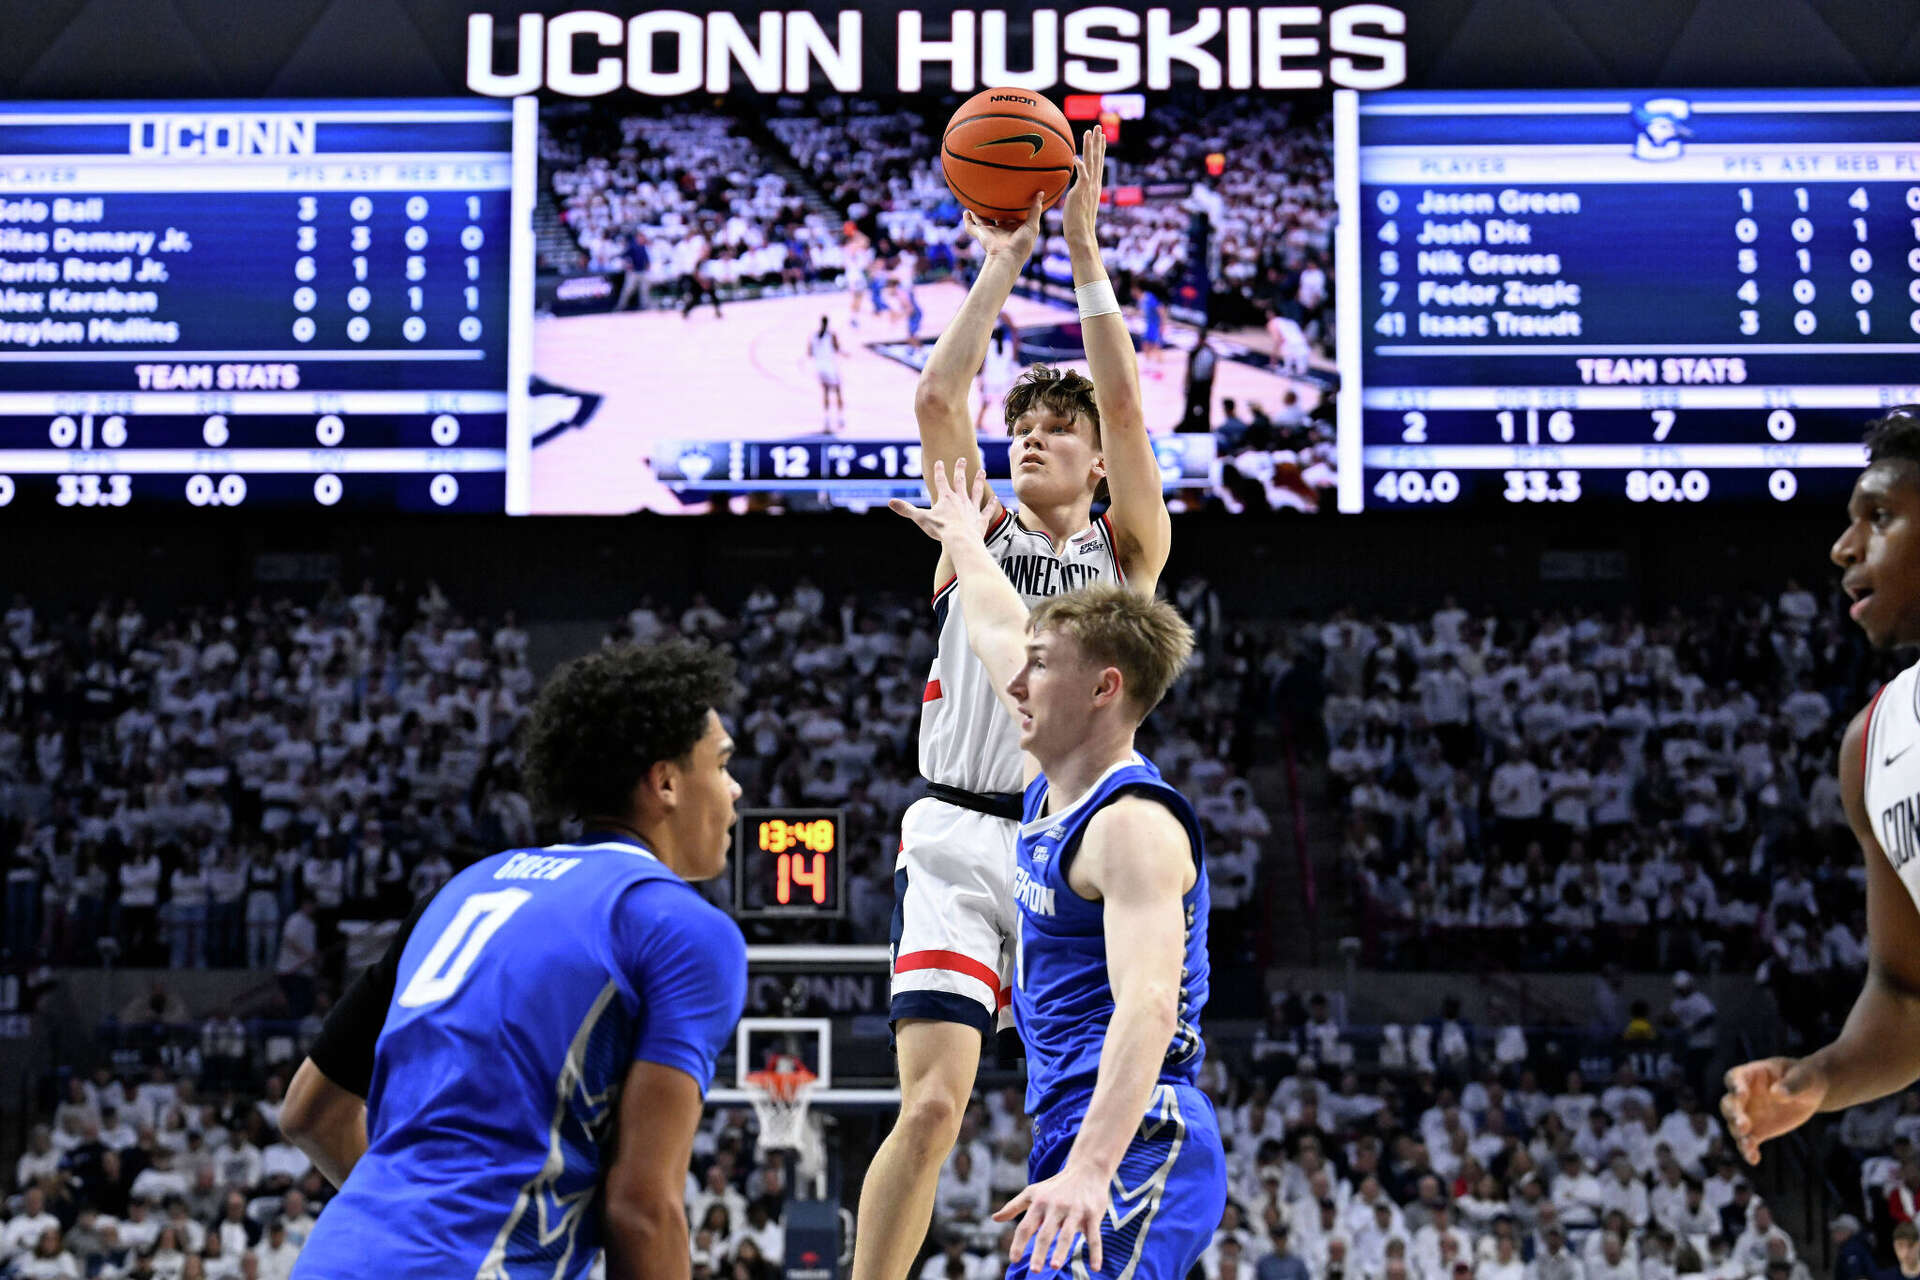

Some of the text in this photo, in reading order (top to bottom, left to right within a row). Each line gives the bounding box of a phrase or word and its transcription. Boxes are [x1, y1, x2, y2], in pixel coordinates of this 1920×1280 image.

[466, 3, 1408, 97] UCONN HUSKIES
[990, 95, 1037, 107] UCONN
[128, 119, 317, 156] UCONN
[298, 196, 317, 221] 3
[350, 196, 373, 221] 0
[405, 196, 429, 221] 0
[467, 196, 480, 219] 1
[1377, 190, 1399, 214] 0
[1739, 188, 1753, 212] 1
[1795, 187, 1809, 212] 1
[1848, 187, 1869, 211] 4
[297, 226, 317, 252] 3
[351, 226, 371, 251] 3
[404, 225, 428, 251] 0
[461, 226, 483, 250] 0
[1378, 221, 1398, 243] 4
[1735, 218, 1758, 243] 0
[1791, 217, 1814, 243] 0
[1853, 217, 1867, 242] 1
[295, 256, 316, 281] 6
[353, 256, 368, 280] 1
[406, 255, 426, 281] 5
[465, 256, 479, 279] 1
[1380, 251, 1399, 275] 5
[1738, 249, 1757, 274] 5
[1796, 248, 1811, 273] 1
[1850, 248, 1872, 273] 0
[0, 288, 44, 313] lex
[293, 287, 317, 312] 0
[347, 286, 371, 312] 0
[408, 286, 423, 311] 1
[464, 286, 478, 310] 1
[1381, 281, 1399, 305] 7
[1737, 280, 1758, 304] 4
[1793, 279, 1816, 304] 0
[1851, 279, 1873, 304] 0
[292, 317, 316, 342] 0
[346, 316, 370, 342] 0
[402, 316, 426, 342] 0
[459, 316, 481, 341] 0
[1375, 312, 1406, 335] 41
[1740, 310, 1759, 335] 3
[1794, 309, 1817, 335] 0
[1856, 309, 1870, 334] 1
[135, 363, 300, 390] TEAM STATS
[1576, 357, 1747, 384] TEAM STATS
[46, 412, 460, 447] 0 6 6 0 0
[1402, 409, 1796, 443] 2 1 6 7 0
[770, 446, 810, 478] 12
[56, 474, 132, 507] 33.3
[185, 474, 247, 507] 0.0
[313, 473, 343, 506] 0
[429, 474, 459, 506] 0
[1374, 469, 1797, 503] 40.0 33.3 80.0 0
[758, 819, 834, 853] 13:48
[493, 852, 583, 881] GREEN
[776, 853, 826, 904] 14
[398, 886, 533, 1008] 0
